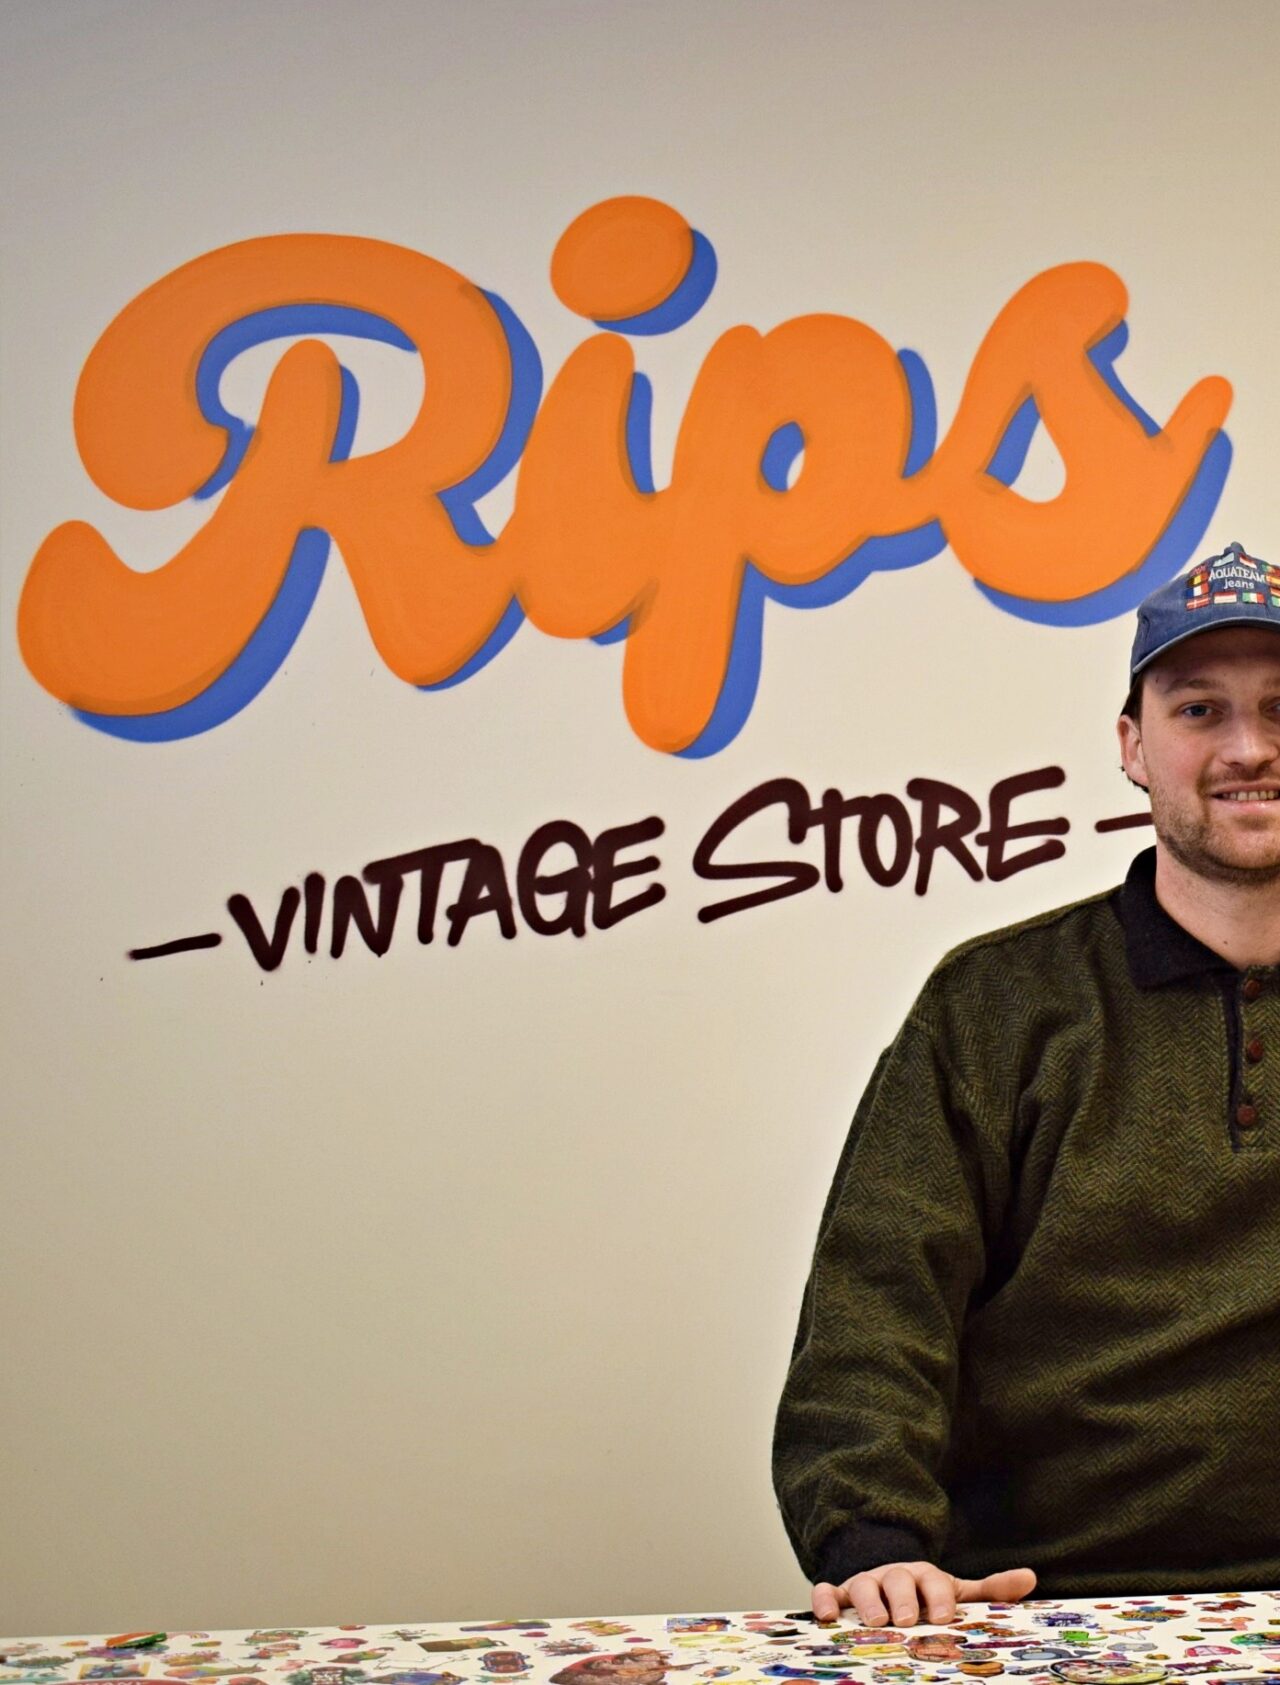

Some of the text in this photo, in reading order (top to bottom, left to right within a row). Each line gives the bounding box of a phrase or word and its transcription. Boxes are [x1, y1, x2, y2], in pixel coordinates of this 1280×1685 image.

[17, 196, 1233, 758] Rips
[1208, 566, 1266, 583] AQUATEAM
[1224, 577, 1255, 589] jeans
[227, 765, 1071, 971] VINTAGE STORE
